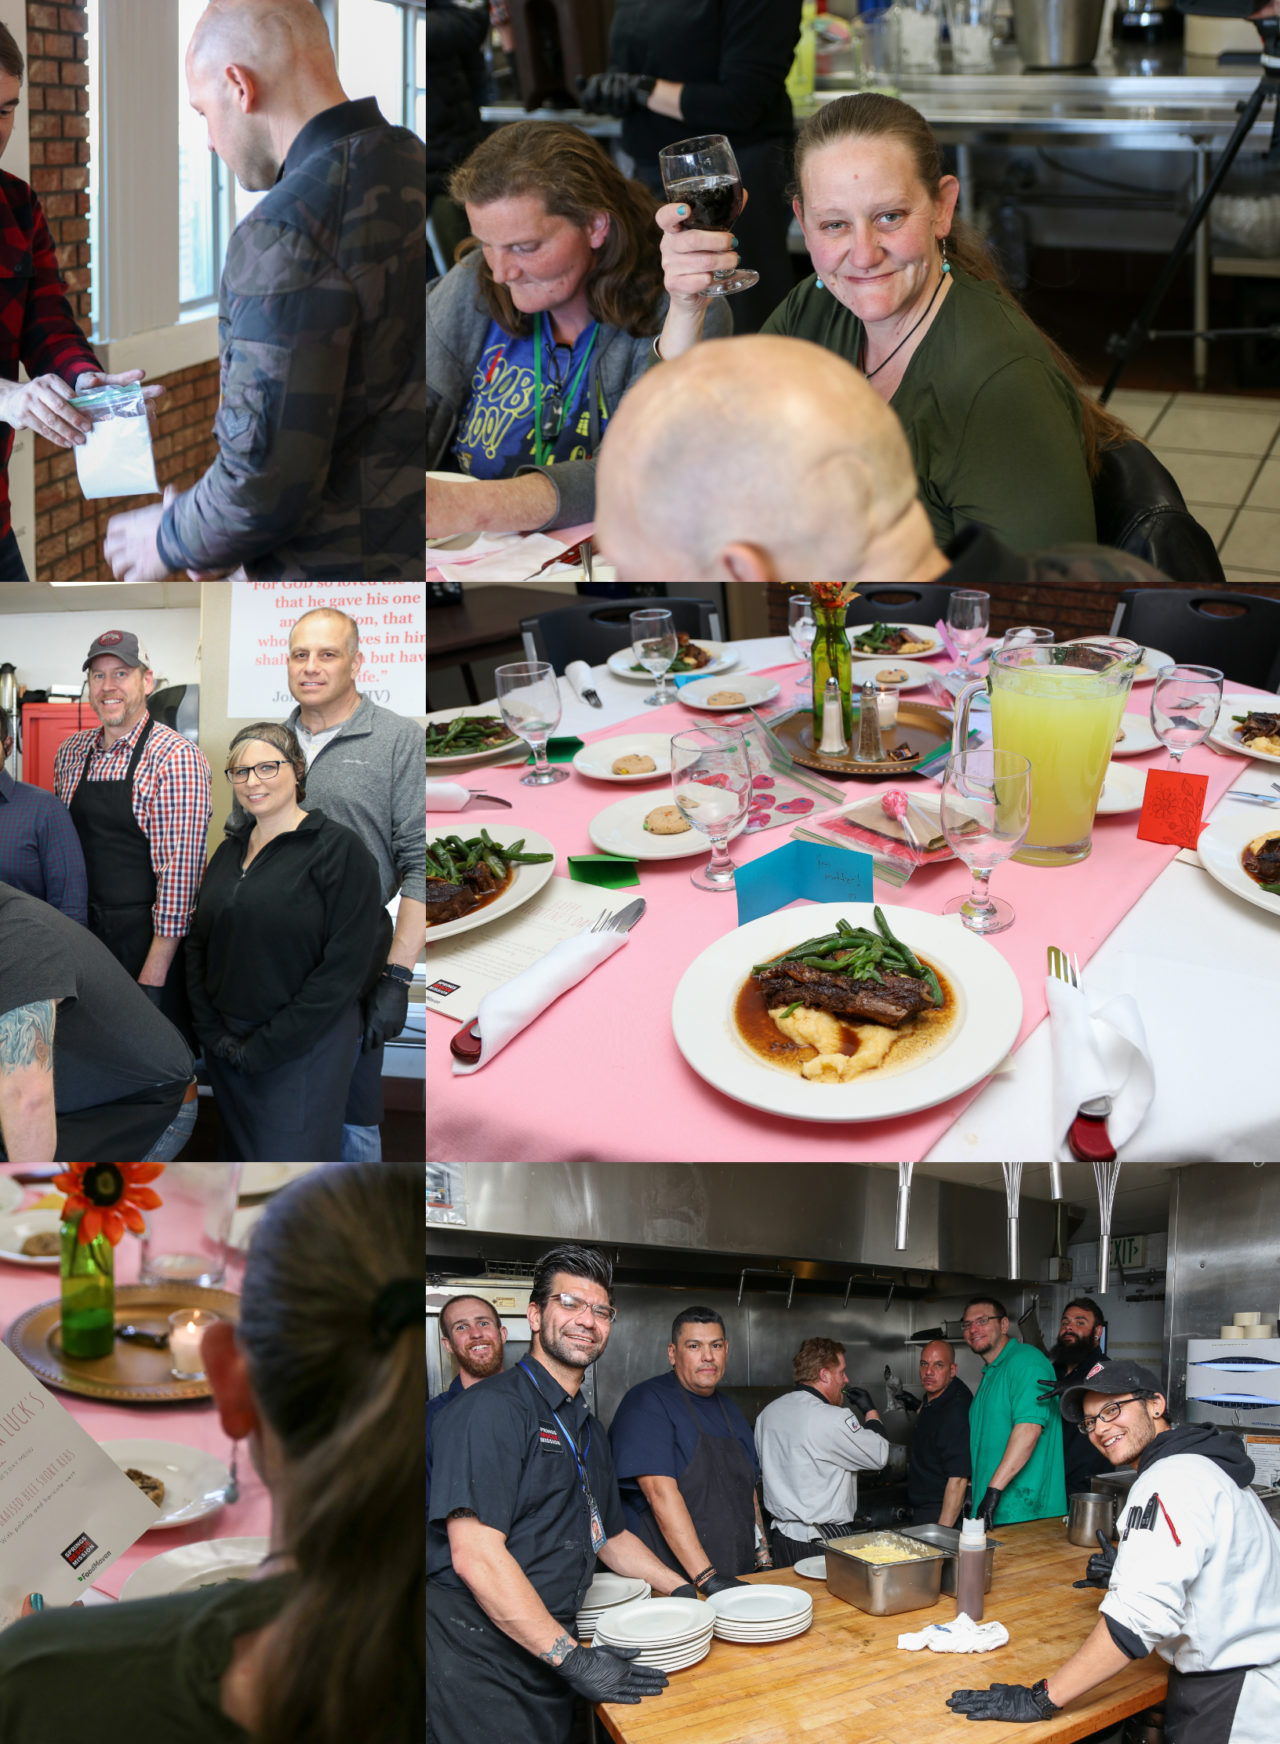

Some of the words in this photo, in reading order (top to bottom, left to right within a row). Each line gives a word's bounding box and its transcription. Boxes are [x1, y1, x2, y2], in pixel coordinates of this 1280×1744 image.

[275, 596, 304, 608] that
[308, 595, 326, 607] he
[329, 595, 363, 609] gave
[367, 592, 389, 606] his
[392, 593, 422, 605] one
[383, 612, 414, 625] that
[385, 632, 400, 645] in
[371, 651, 394, 665] but
[399, 650, 426, 664] hav
[21, 1483, 40, 1502] BEEF
[35, 1463, 58, 1488] SHORT
[55, 1448, 77, 1468] RIBS
[0, 1531, 14, 1545] With
[14, 1512, 34, 1533] polenta
[33, 1500, 44, 1513] and
[64, 1535, 87, 1558] SPRINGS
[67, 1539, 92, 1562] RESCUE
[71, 1543, 96, 1567] MISSION
[81, 1550, 112, 1581] FoodMaven
